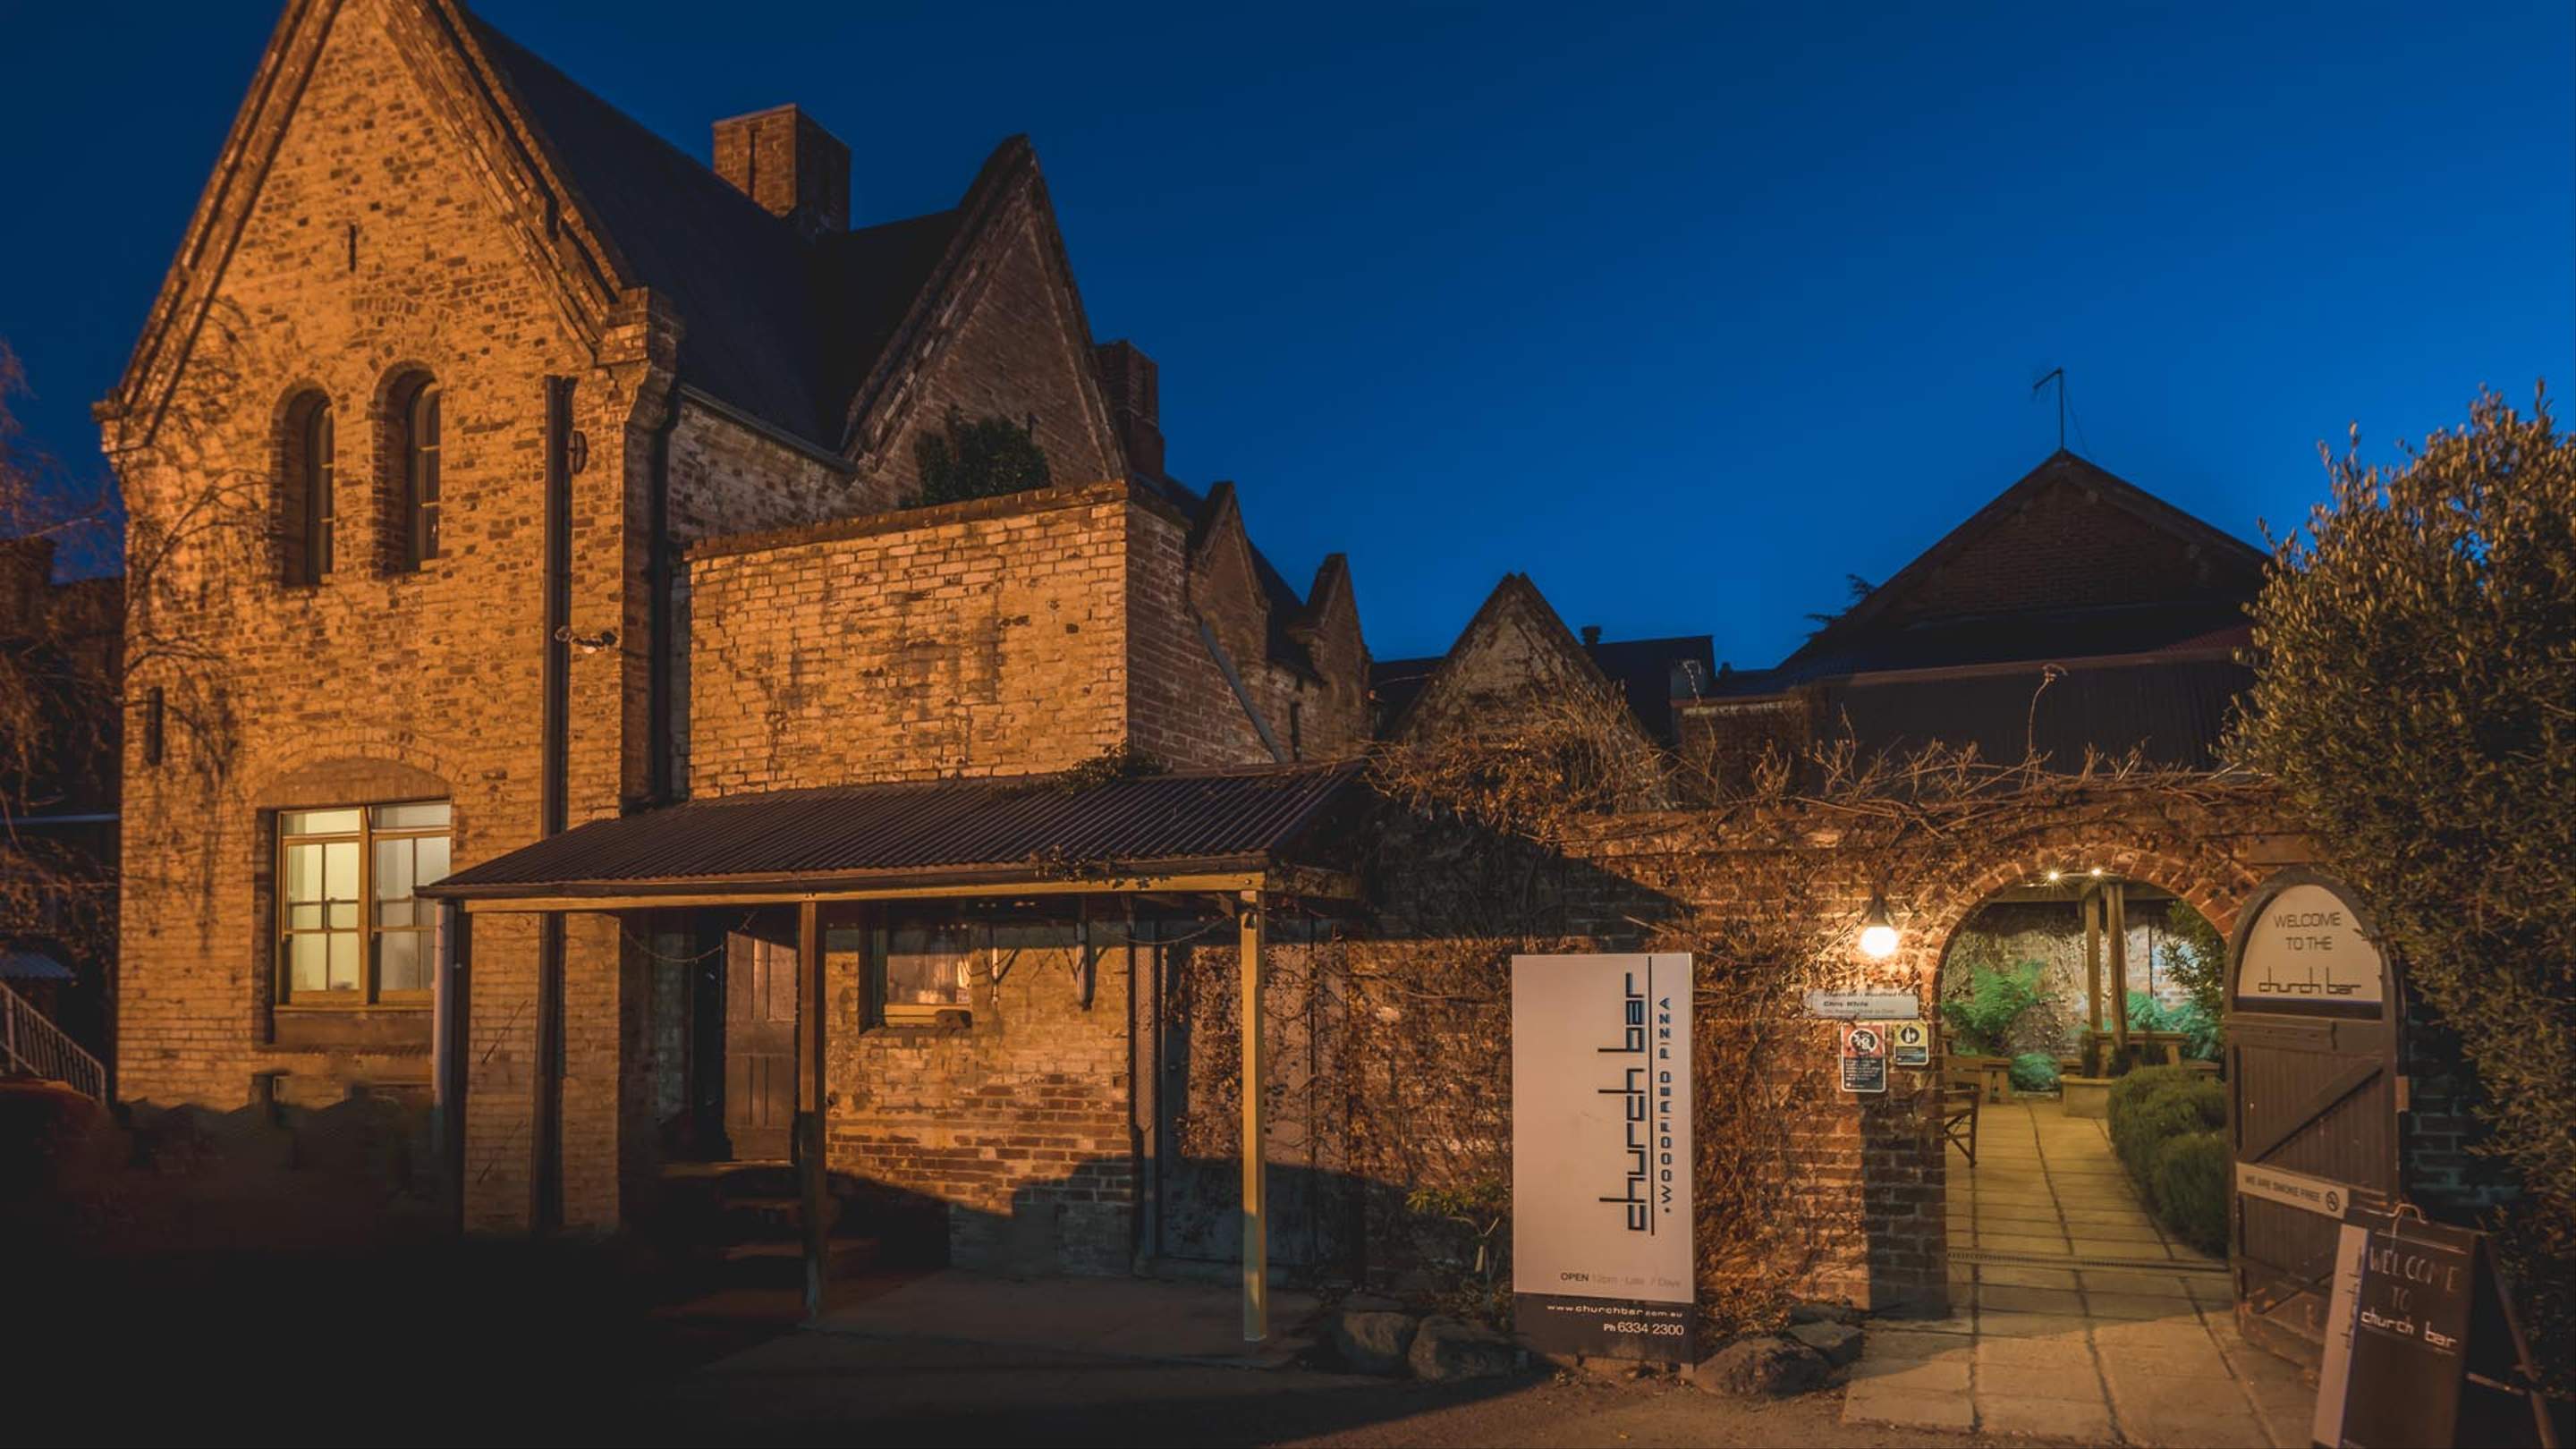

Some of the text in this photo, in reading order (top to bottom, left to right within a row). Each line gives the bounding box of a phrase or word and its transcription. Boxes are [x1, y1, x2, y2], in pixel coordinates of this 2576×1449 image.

[2275, 912, 2341, 928] WELCOME
[2286, 936, 2333, 951] TO THE
[2258, 966, 2361, 995] church bar
[1597, 972, 1647, 1231] church bar
[1659, 997, 1673, 1204] WOODFIRED PIZZA
[1560, 1272, 1589, 1282] OPEN
[2369, 1246, 2460, 1292] WELCOME
[1604, 1321, 1684, 1335] Ph 6334 2300
[2360, 1308, 2457, 1347] church bar
